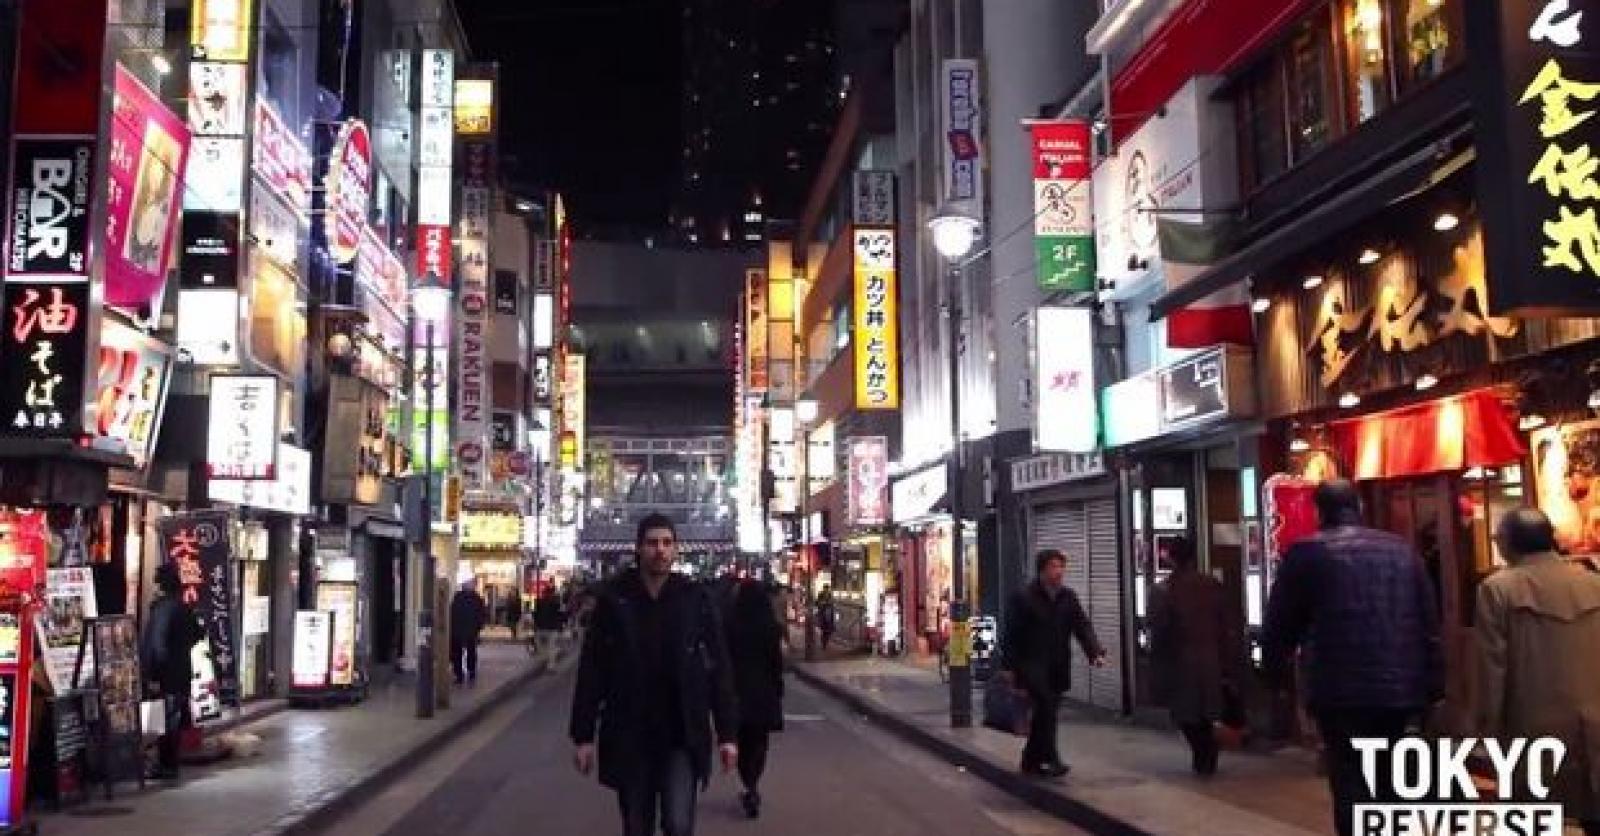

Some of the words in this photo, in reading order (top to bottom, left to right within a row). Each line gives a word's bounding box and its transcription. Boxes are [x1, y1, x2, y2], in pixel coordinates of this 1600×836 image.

[27, 158, 72, 260] BAR
[1052, 244, 1078, 262] 2F
[463, 321, 482, 422] RAKUEN
[866, 337, 888, 403] とんかつ
